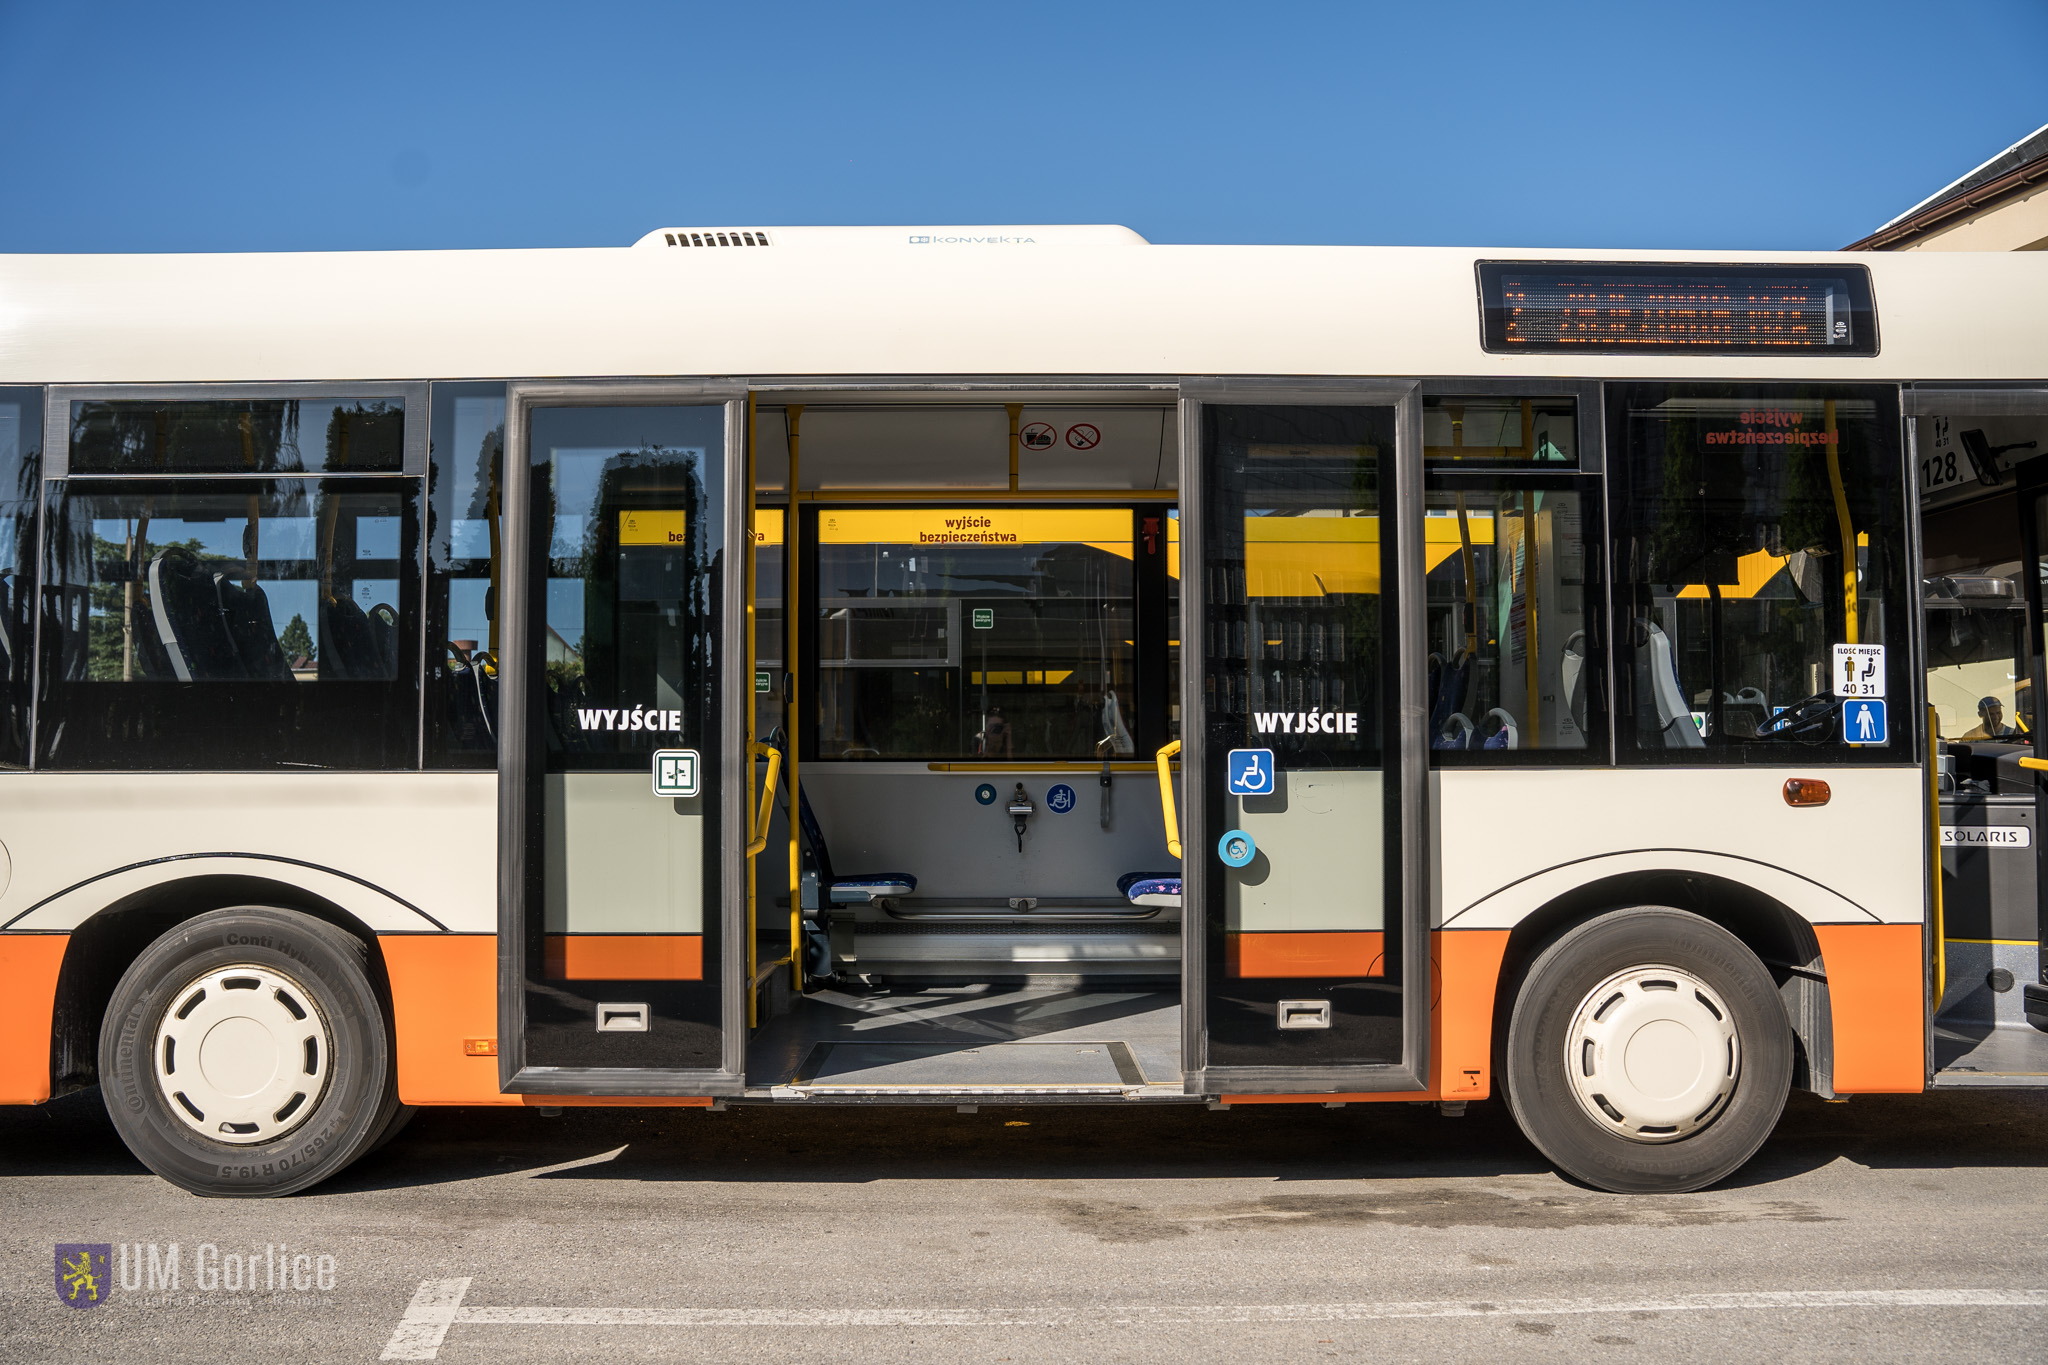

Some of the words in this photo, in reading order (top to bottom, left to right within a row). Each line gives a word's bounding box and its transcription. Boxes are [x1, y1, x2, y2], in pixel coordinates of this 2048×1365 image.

[933, 236, 1036, 244] KONVEKTA
[945, 516, 991, 530] wyjście
[919, 530, 1017, 545] bezpieczeństwa
[1837, 647, 1857, 655] ILOŚĆ
[1858, 648, 1881, 657] MIEJSC
[1842, 683, 1857, 694] 40
[1862, 683, 1875, 694] 31
[577, 704, 682, 731] WYJŚCIE
[1254, 707, 1358, 733] WYJŚCIE
[1944, 831, 2018, 843] SOLARIS
[226, 932, 273, 948] Conti
[117, 1010, 146, 1116] Continental
[279, 1130, 333, 1172] 265/70
